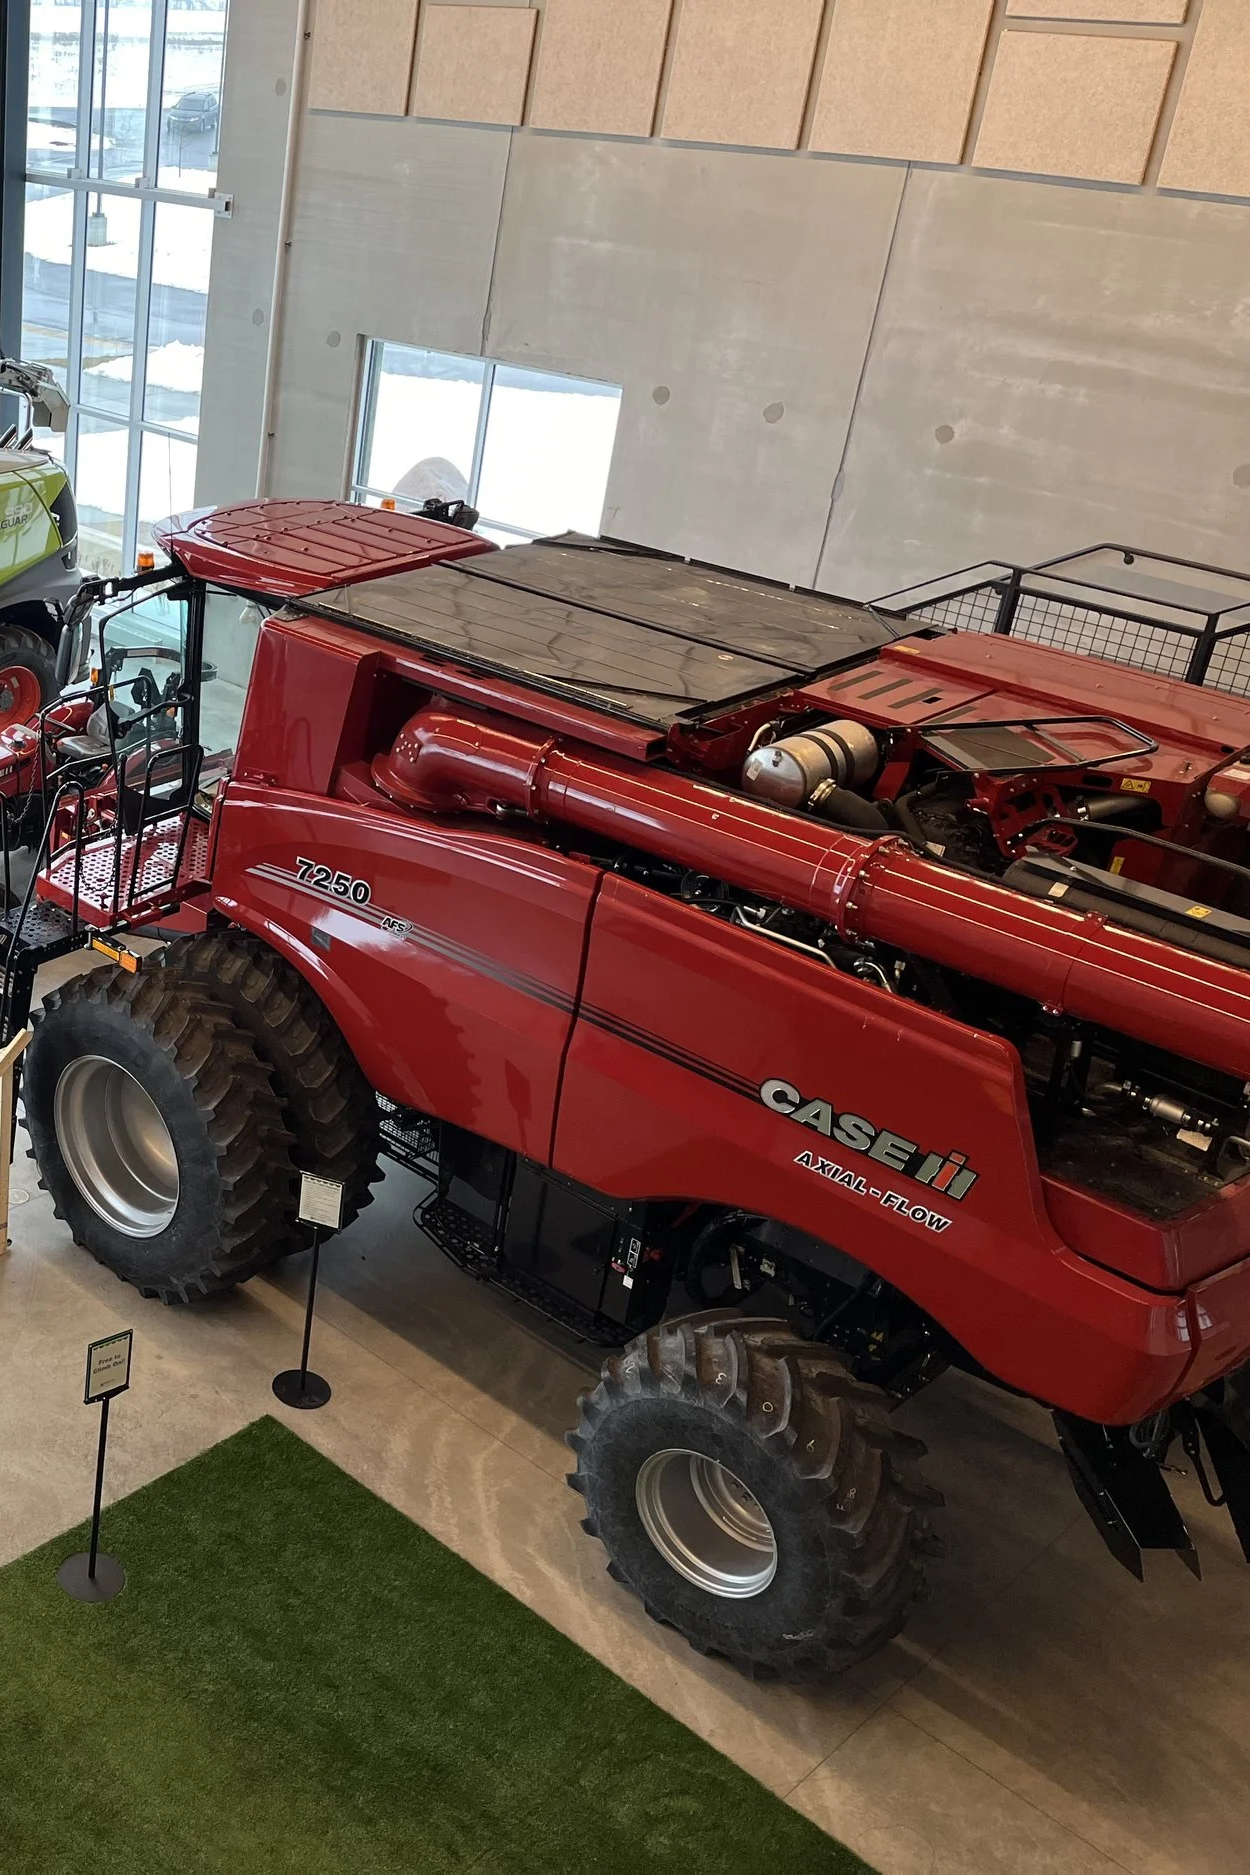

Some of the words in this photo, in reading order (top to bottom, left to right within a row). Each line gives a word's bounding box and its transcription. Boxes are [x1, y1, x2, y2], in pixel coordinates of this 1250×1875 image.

[296, 856, 371, 905] 7250
[381, 916, 407, 933] AFS
[760, 1078, 917, 1171] CASE
[93, 1364, 111, 1374] Climb
